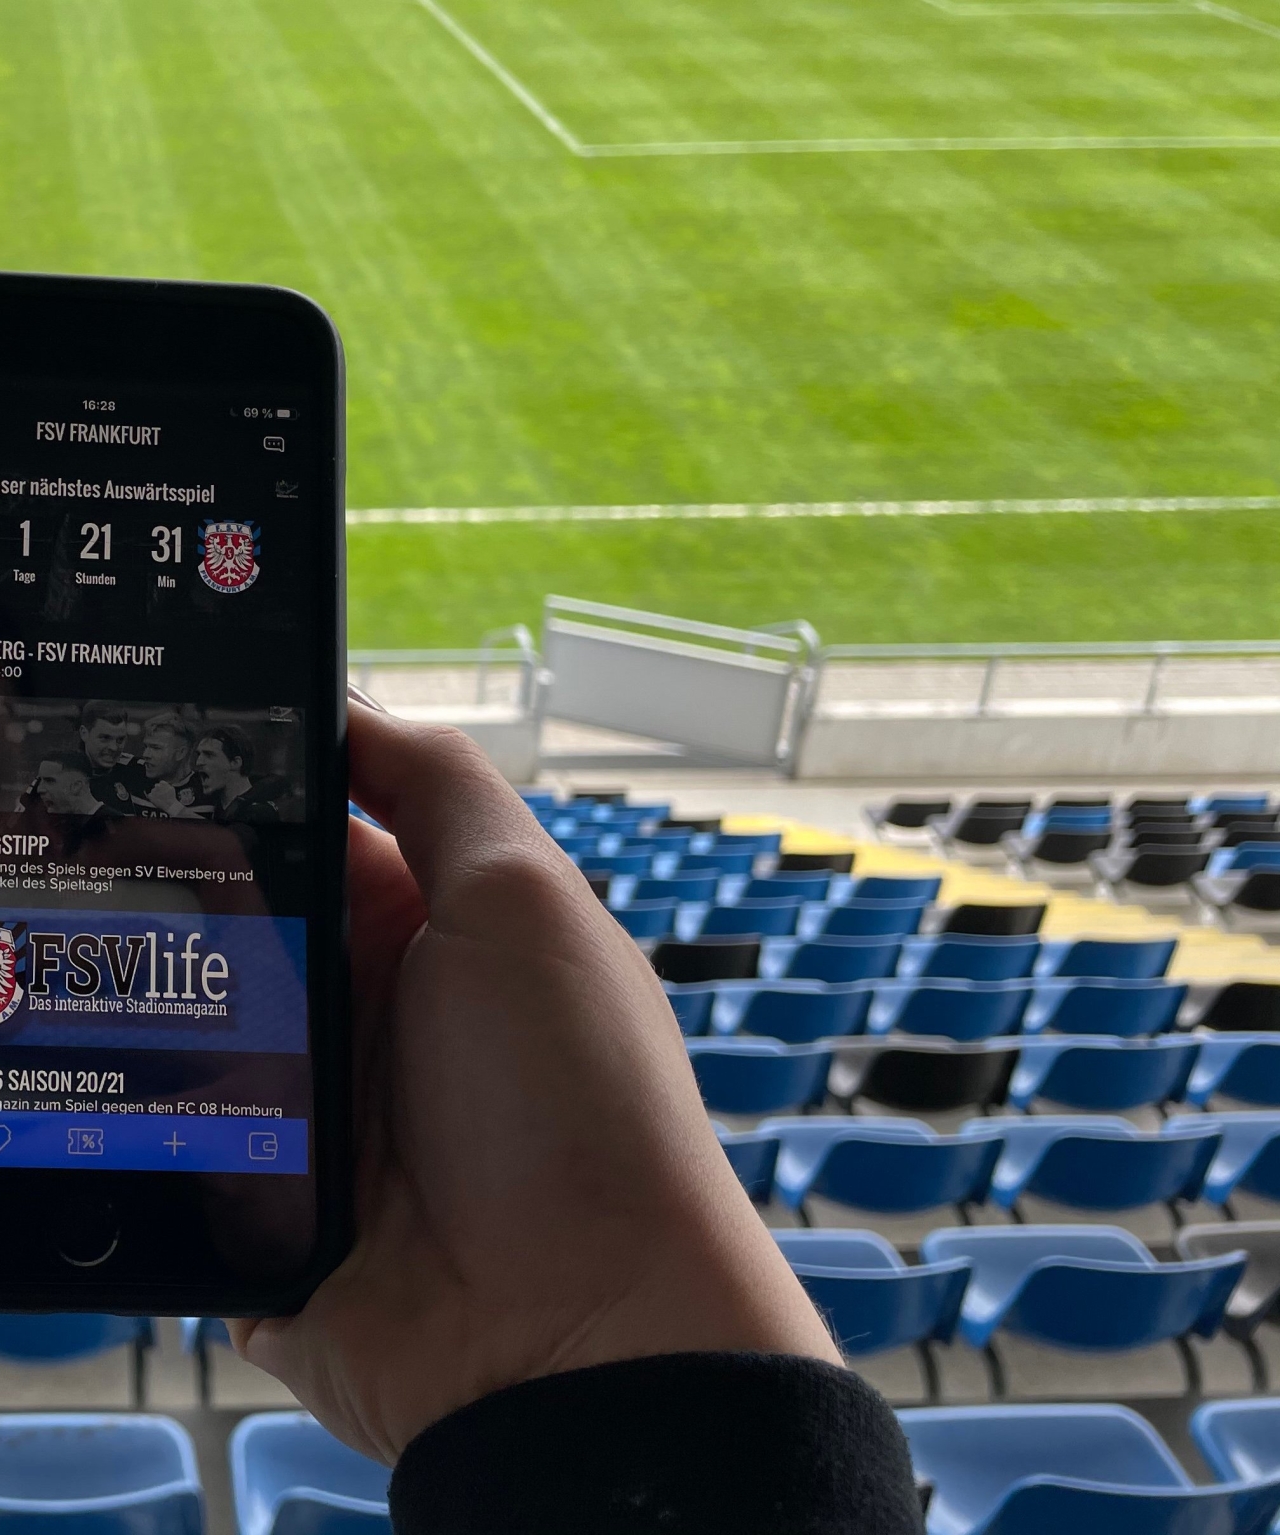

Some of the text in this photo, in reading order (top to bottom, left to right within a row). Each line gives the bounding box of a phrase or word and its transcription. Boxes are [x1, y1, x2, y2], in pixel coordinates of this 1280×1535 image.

[82, 400, 116, 411] 16:28
[243, 407, 273, 419] 69 %
[36, 421, 162, 446] FSV FRANKFURT
[30, 478, 101, 498] nächstes
[104, 480, 215, 506] Auswärtsspiel
[19, 519, 31, 557] 1
[80, 522, 112, 560] 21
[151, 525, 182, 563] 31
[13, 569, 36, 584] Tage
[75, 572, 116, 586] Stunden
[157, 575, 176, 588] Min
[37, 641, 67, 663] FSV
[71, 643, 164, 666] FRANKFURT
[20, 862, 43, 874] des
[47, 862, 86, 877] Spiels
[89, 866, 131, 880] gegen
[135, 866, 154, 878] SV
[156, 866, 225, 884] Elversberg
[229, 870, 254, 882] und
[22, 877, 46, 890] des
[49, 878, 113, 894] Spieltags!
[2, 999, 20, 1020] A.M.
[29, 995, 227, 1019] Das interaktive Stadionmagazin
[8, 1070, 72, 1092] SAISON
[76, 1071, 124, 1094] 20/21
[33, 1101, 61, 1111] zum
[65, 1099, 98, 1114] Spiel
[102, 1102, 144, 1115] gegen
[147, 1101, 173, 1114] den
[177, 1101, 196, 1115] FC
[199, 1102, 217, 1115] 08
[221, 1103, 283, 1119] Homburg
